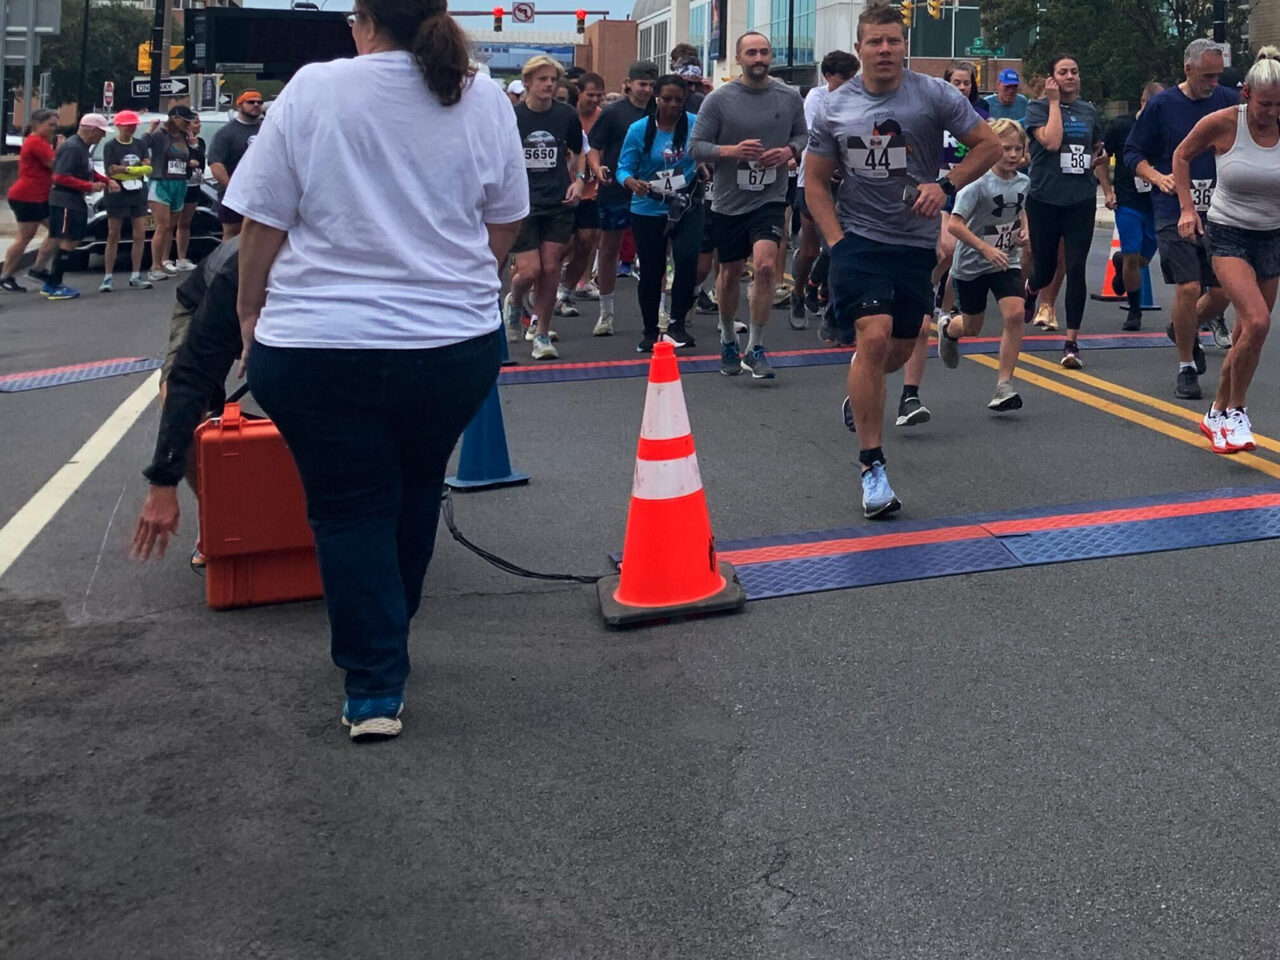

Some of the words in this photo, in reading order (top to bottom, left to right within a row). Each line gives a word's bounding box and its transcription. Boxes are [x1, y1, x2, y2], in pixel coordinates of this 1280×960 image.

[138, 84, 150, 92] ON
[525, 148, 555, 160] 5650
[865, 148, 890, 170] 44
[1071, 152, 1085, 168] 58
[665, 178, 673, 191] 4
[749, 169, 766, 185] 67
[1193, 188, 1211, 205] 36
[995, 231, 1012, 249] 43
